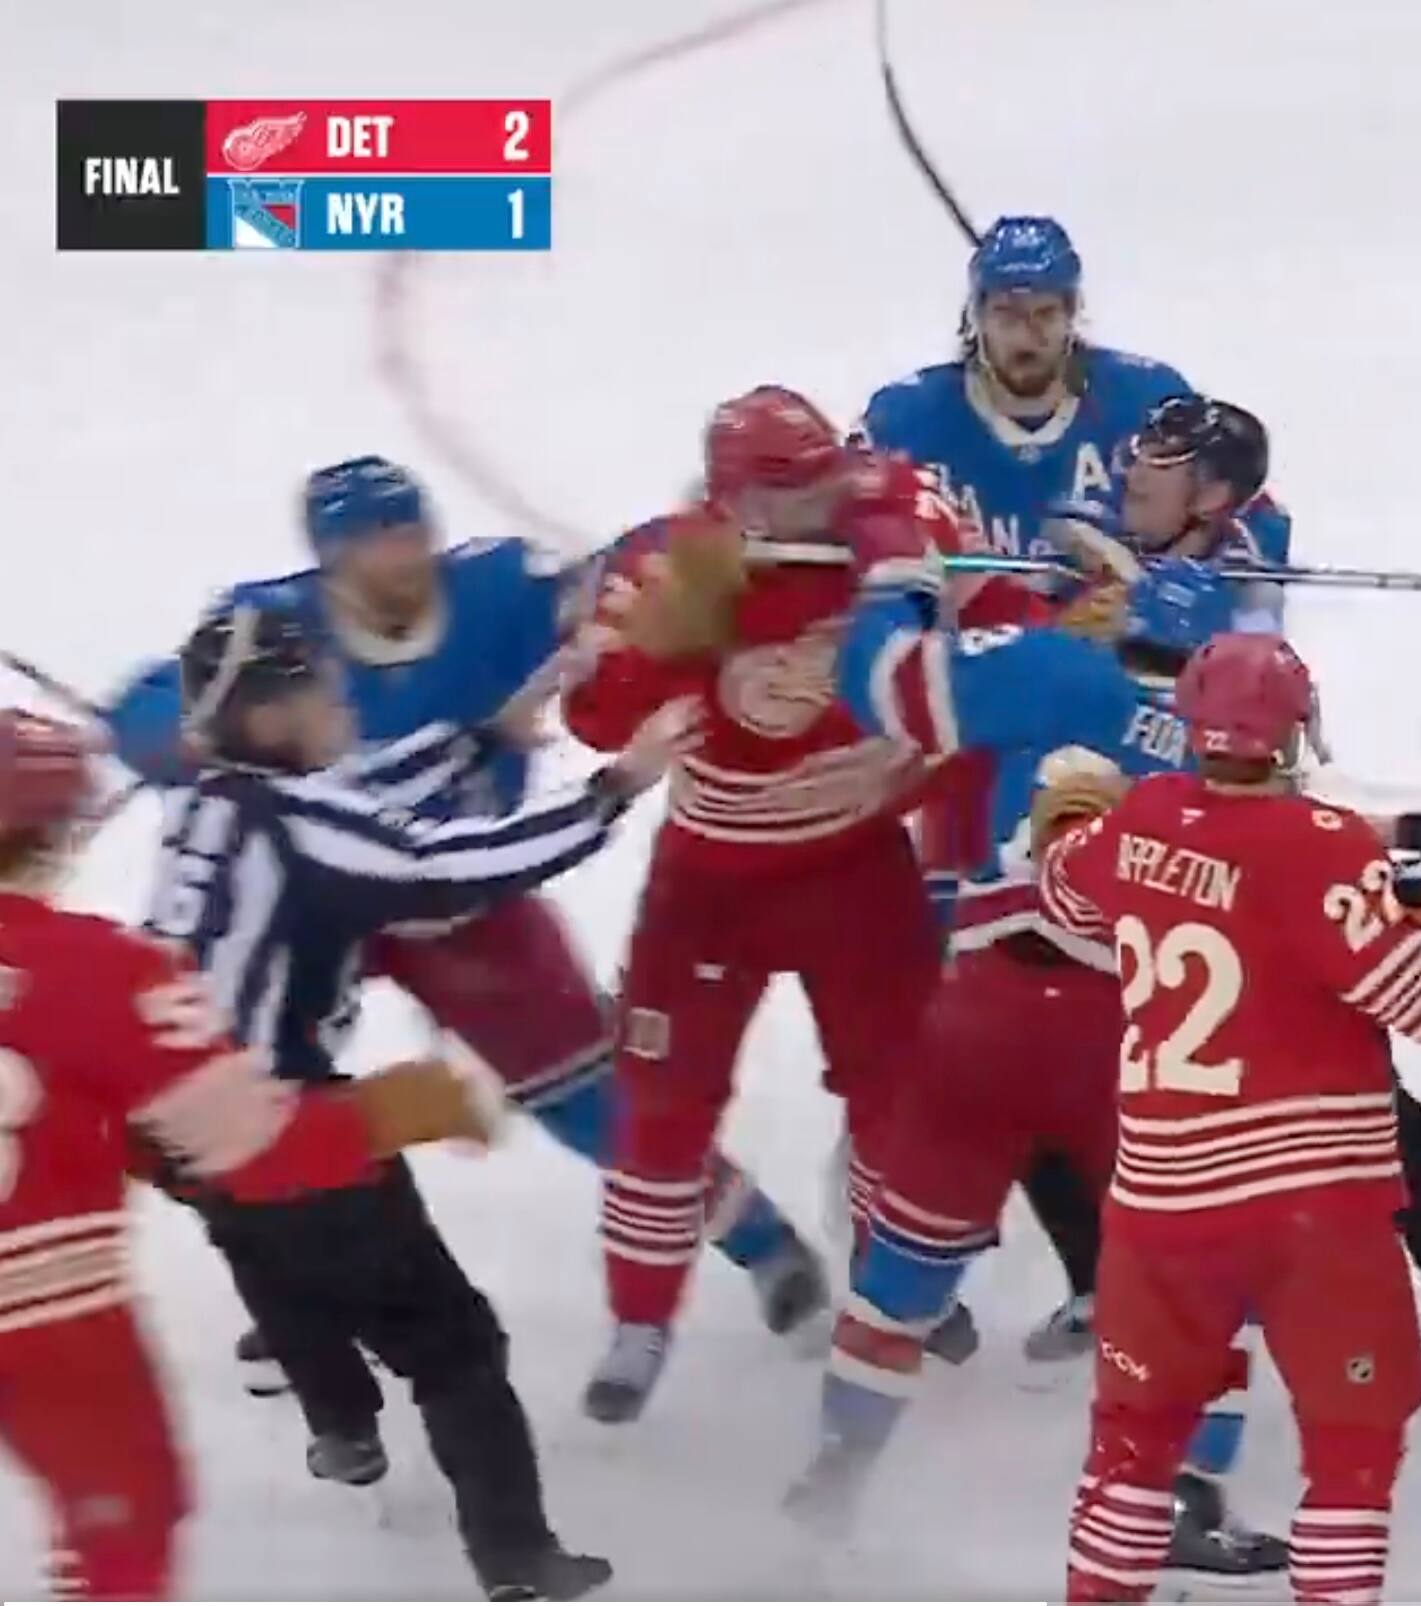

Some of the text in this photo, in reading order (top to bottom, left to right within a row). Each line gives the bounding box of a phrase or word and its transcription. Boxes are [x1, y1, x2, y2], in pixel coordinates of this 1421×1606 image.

[1072, 441, 1112, 502] A
[1116, 832, 1241, 912] APPLETON
[1115, 914, 1244, 1096] 22
